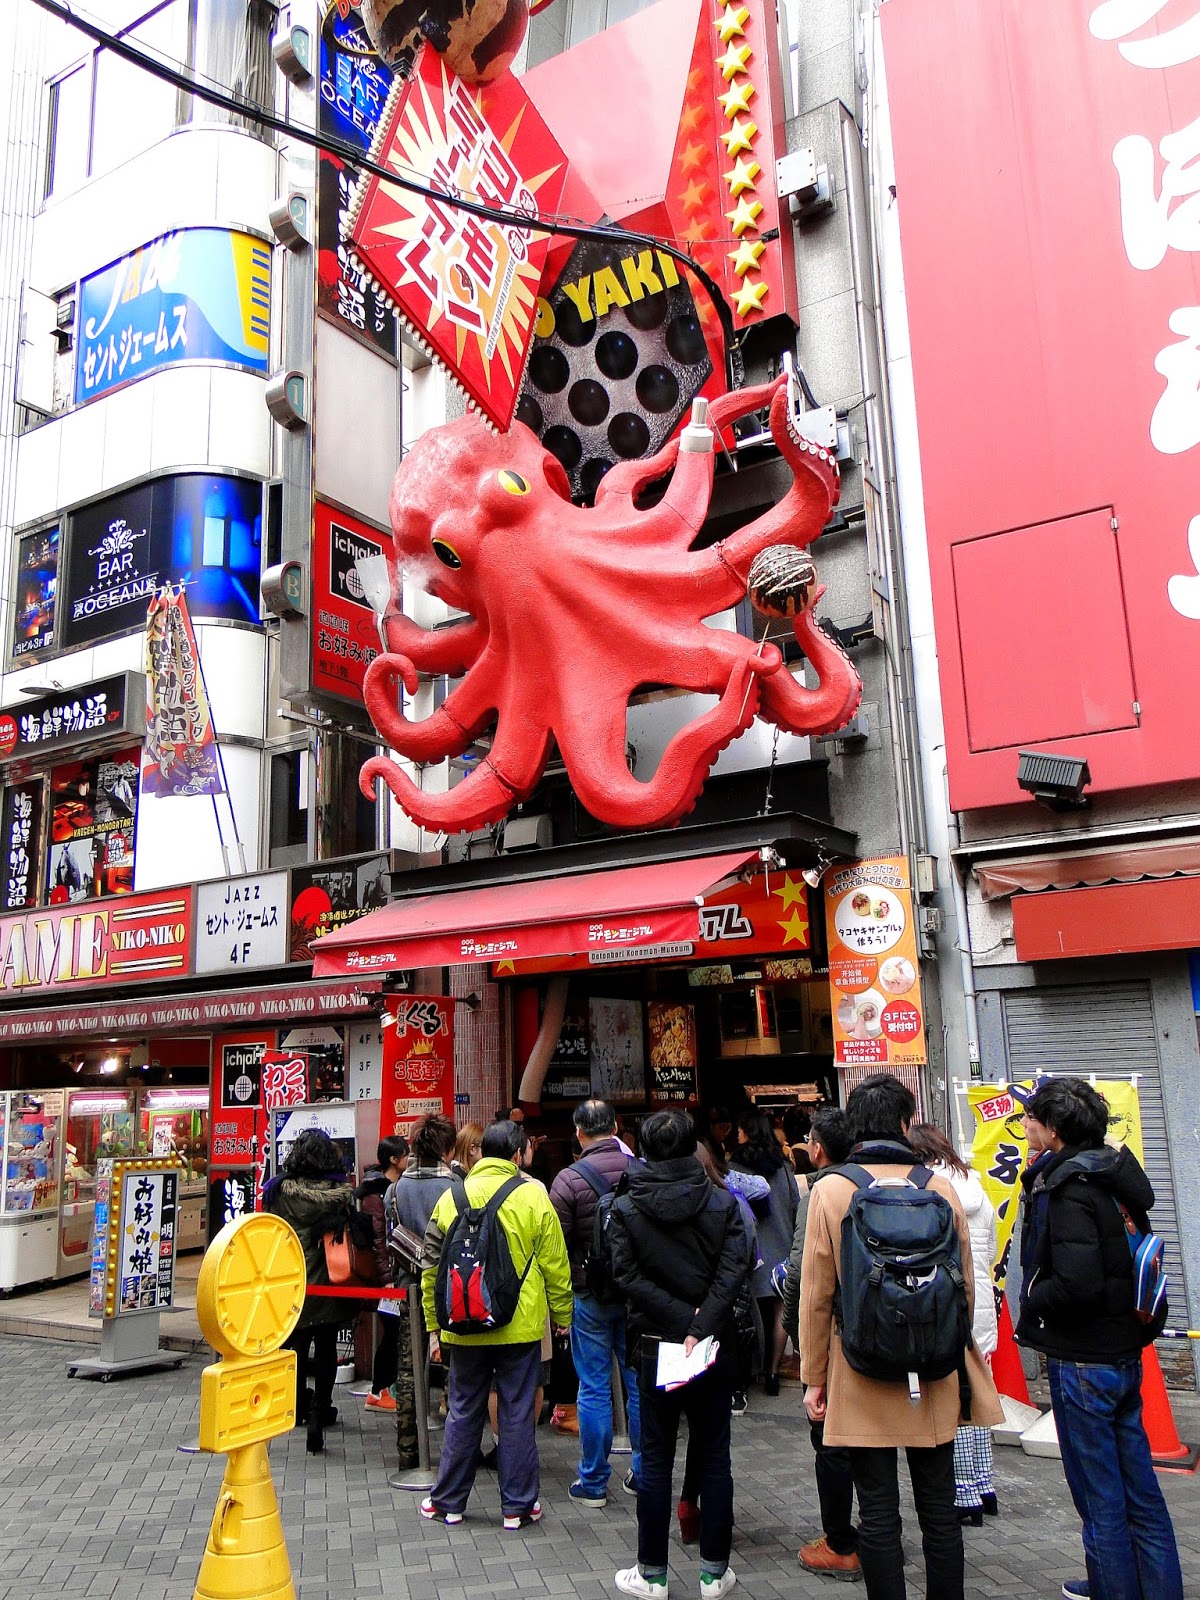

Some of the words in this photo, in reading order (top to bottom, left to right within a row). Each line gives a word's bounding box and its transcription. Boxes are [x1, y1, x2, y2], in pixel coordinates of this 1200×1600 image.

[337, 57, 380, 110] BAR
[561, 248, 680, 324] YAKI
[97, 552, 133, 580] BAR
[20, 692, 107, 742] 海鮮物語
[8, 791, 32, 907] 海鮮物語
[111, 923, 186, 952] NIKO-NIKO
[0, 910, 109, 990] AME
[151, 1006, 199, 1024] NIKO-NIKO
[203, 1002, 255, 1018] NIKO-NIKO
[259, 996, 315, 1014] NIKO-NIKO
[10, 1020, 52, 1036] NIKO-NIKO
[56, 1016, 98, 1031] NIKO-NIKO
[102, 1012, 148, 1028] NIKO-NIKO
[406, 1001, 441, 1035] くくる
[360, 1061, 371, 1071] 3F
[360, 1088, 371, 1098] 2F
[982, 1097, 1012, 1118] 名物
[128, 1176, 156, 1274] お好み焼
